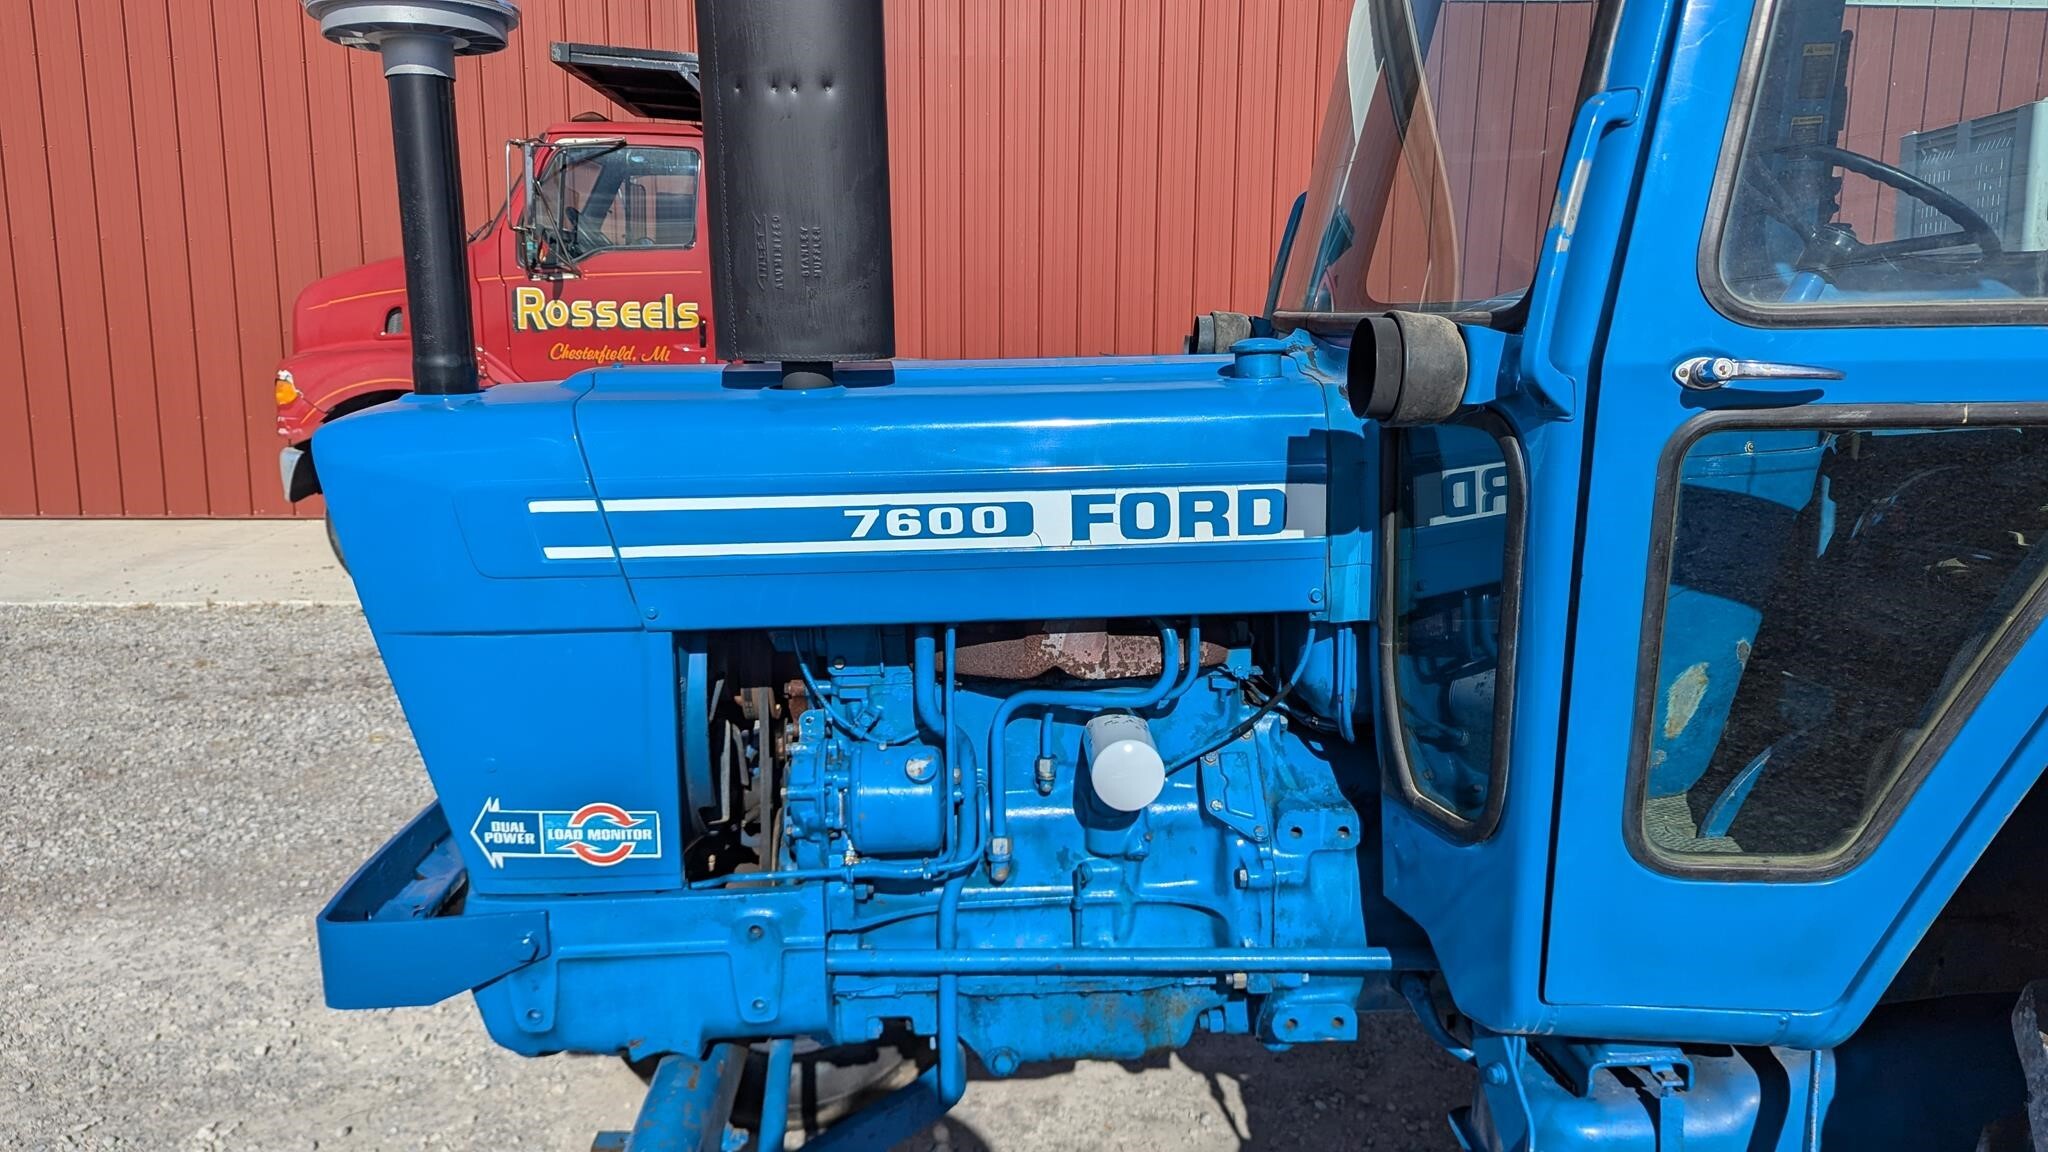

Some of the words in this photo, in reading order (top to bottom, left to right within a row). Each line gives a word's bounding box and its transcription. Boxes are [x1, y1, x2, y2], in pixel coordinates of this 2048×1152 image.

[513, 286, 700, 331] Rosseels
[843, 505, 1007, 538] 7600
[1071, 487, 1288, 541] FORD
[490, 820, 527, 833] DUAL
[484, 832, 536, 845] POWER
[547, 828, 583, 841] LOAD
[587, 828, 652, 841] MONITOR
